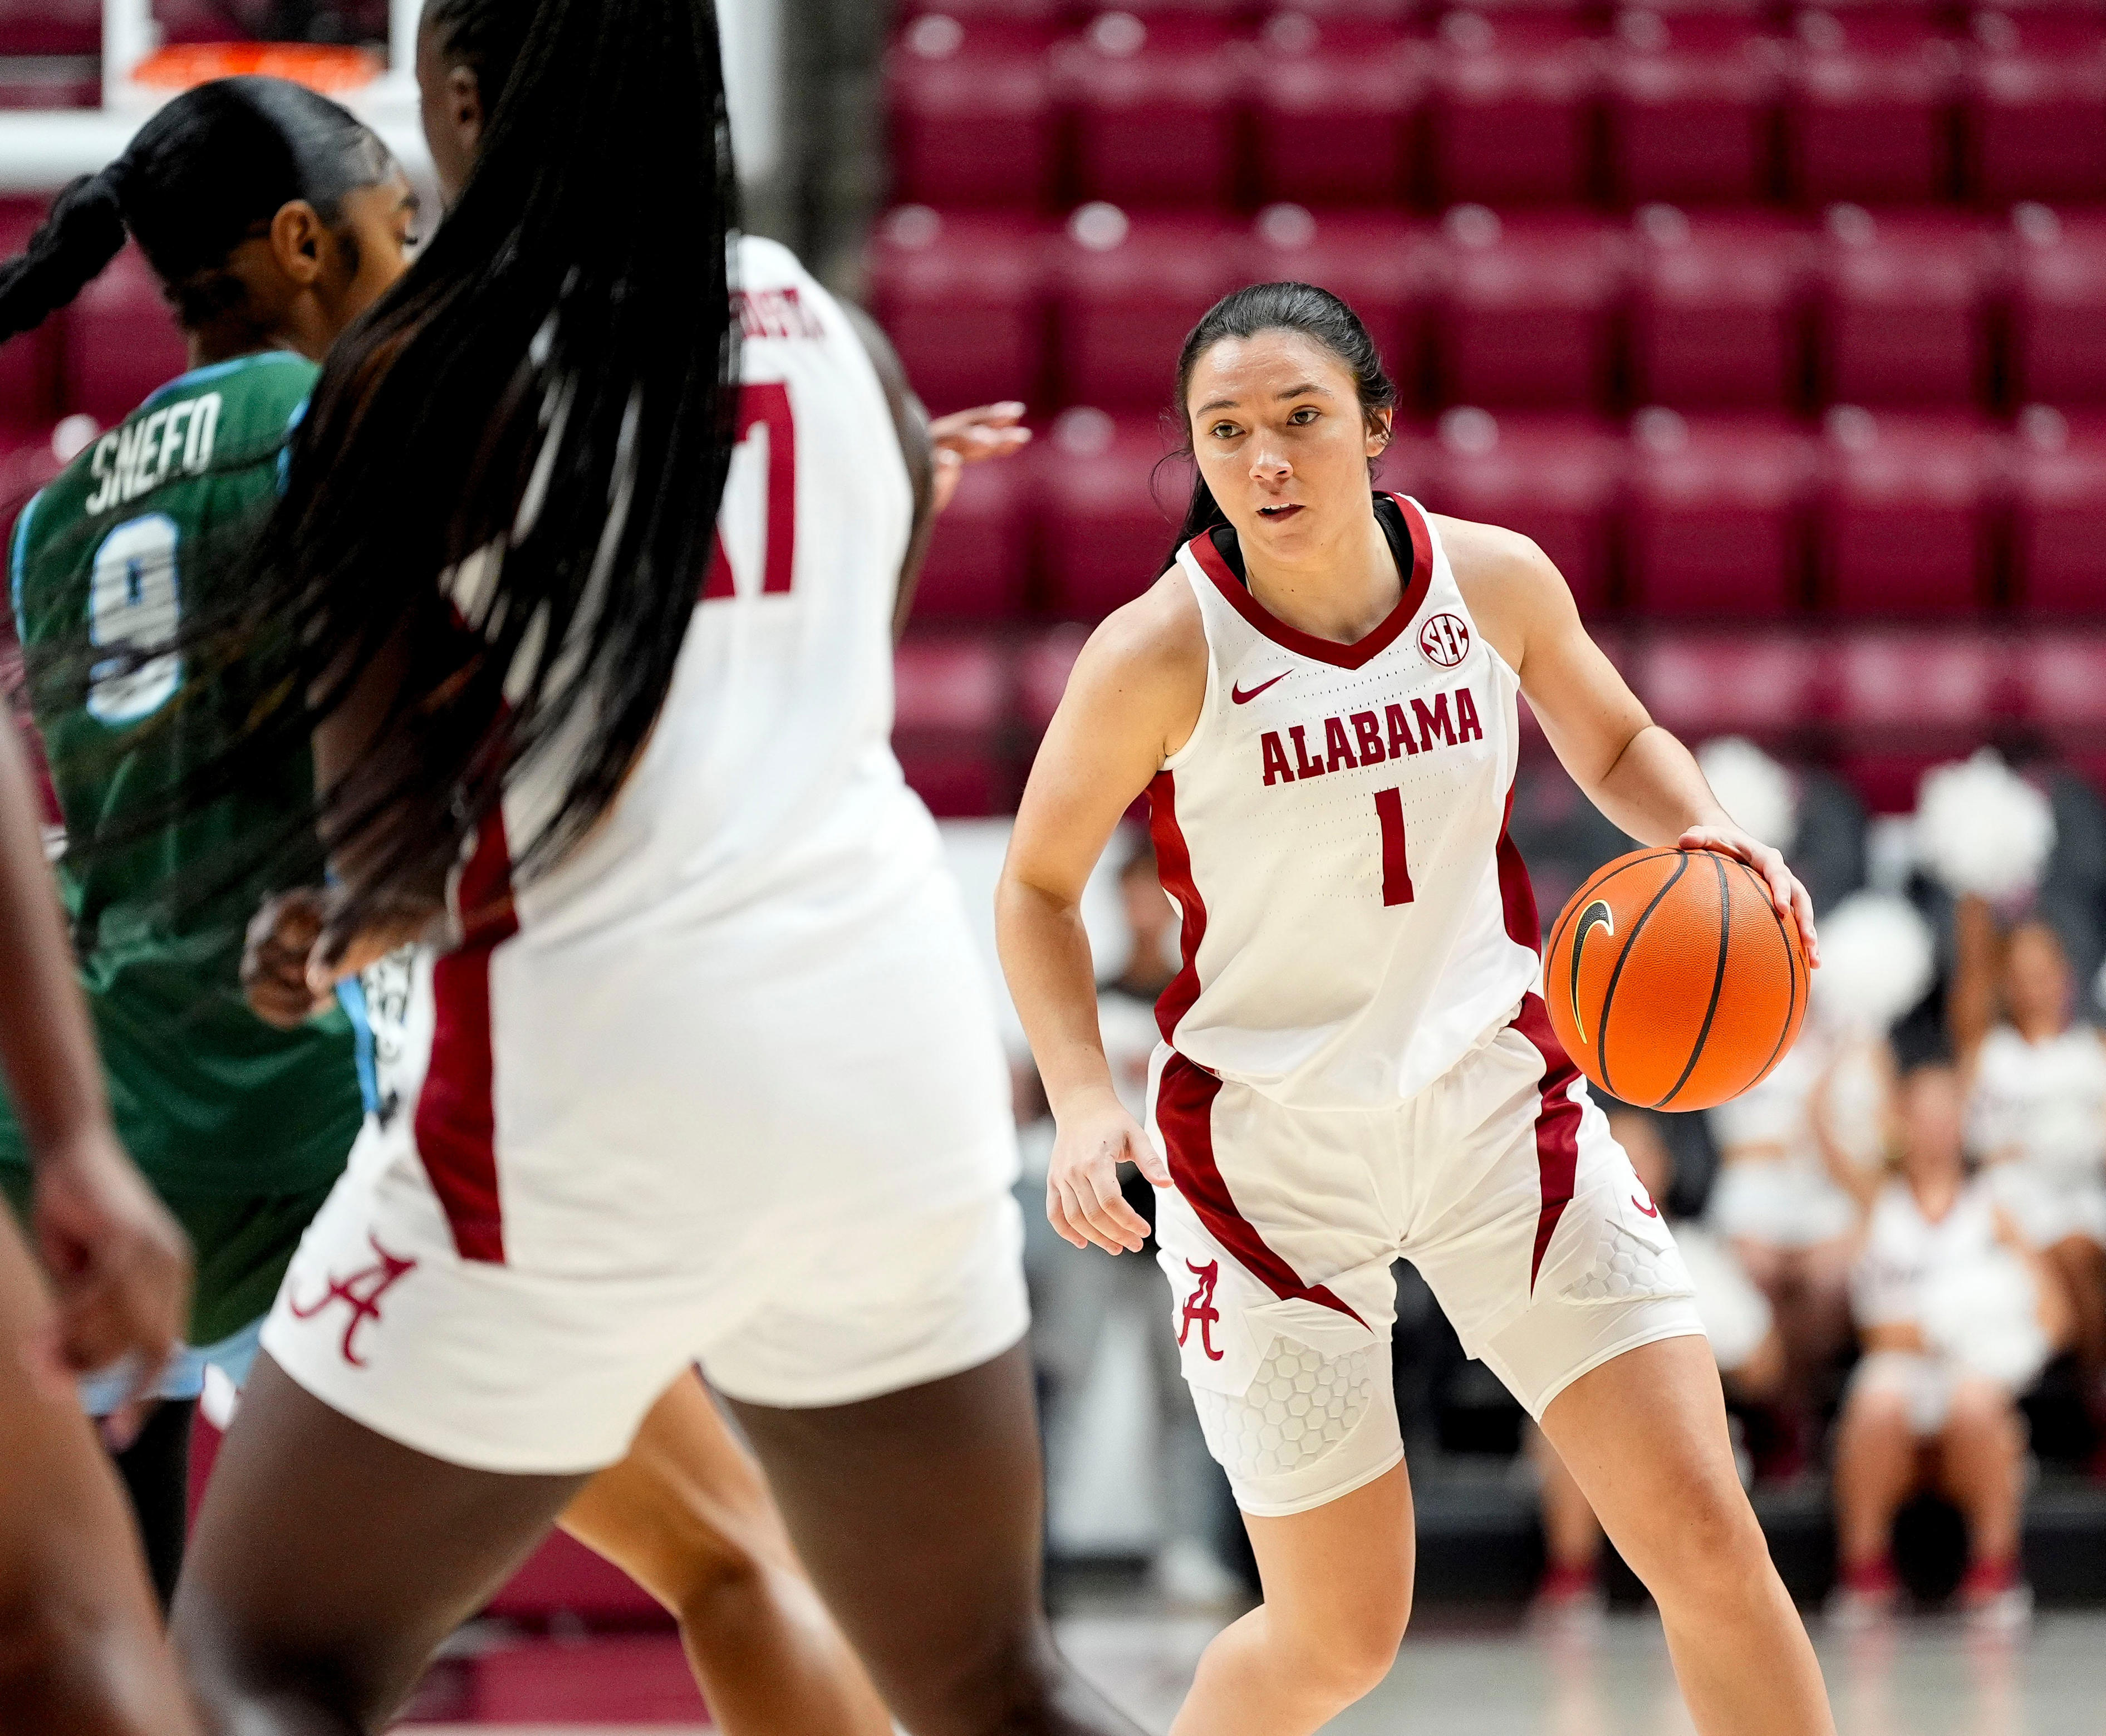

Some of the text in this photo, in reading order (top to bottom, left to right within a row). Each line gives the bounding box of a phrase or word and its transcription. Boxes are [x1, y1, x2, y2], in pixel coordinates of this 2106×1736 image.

[1422, 615, 1468, 665] SEC
[1260, 688, 1482, 787] ALABAMA
[1374, 787, 1415, 907] 1
[289, 1224, 419, 1367] A
[1174, 1257, 1224, 1361] A
